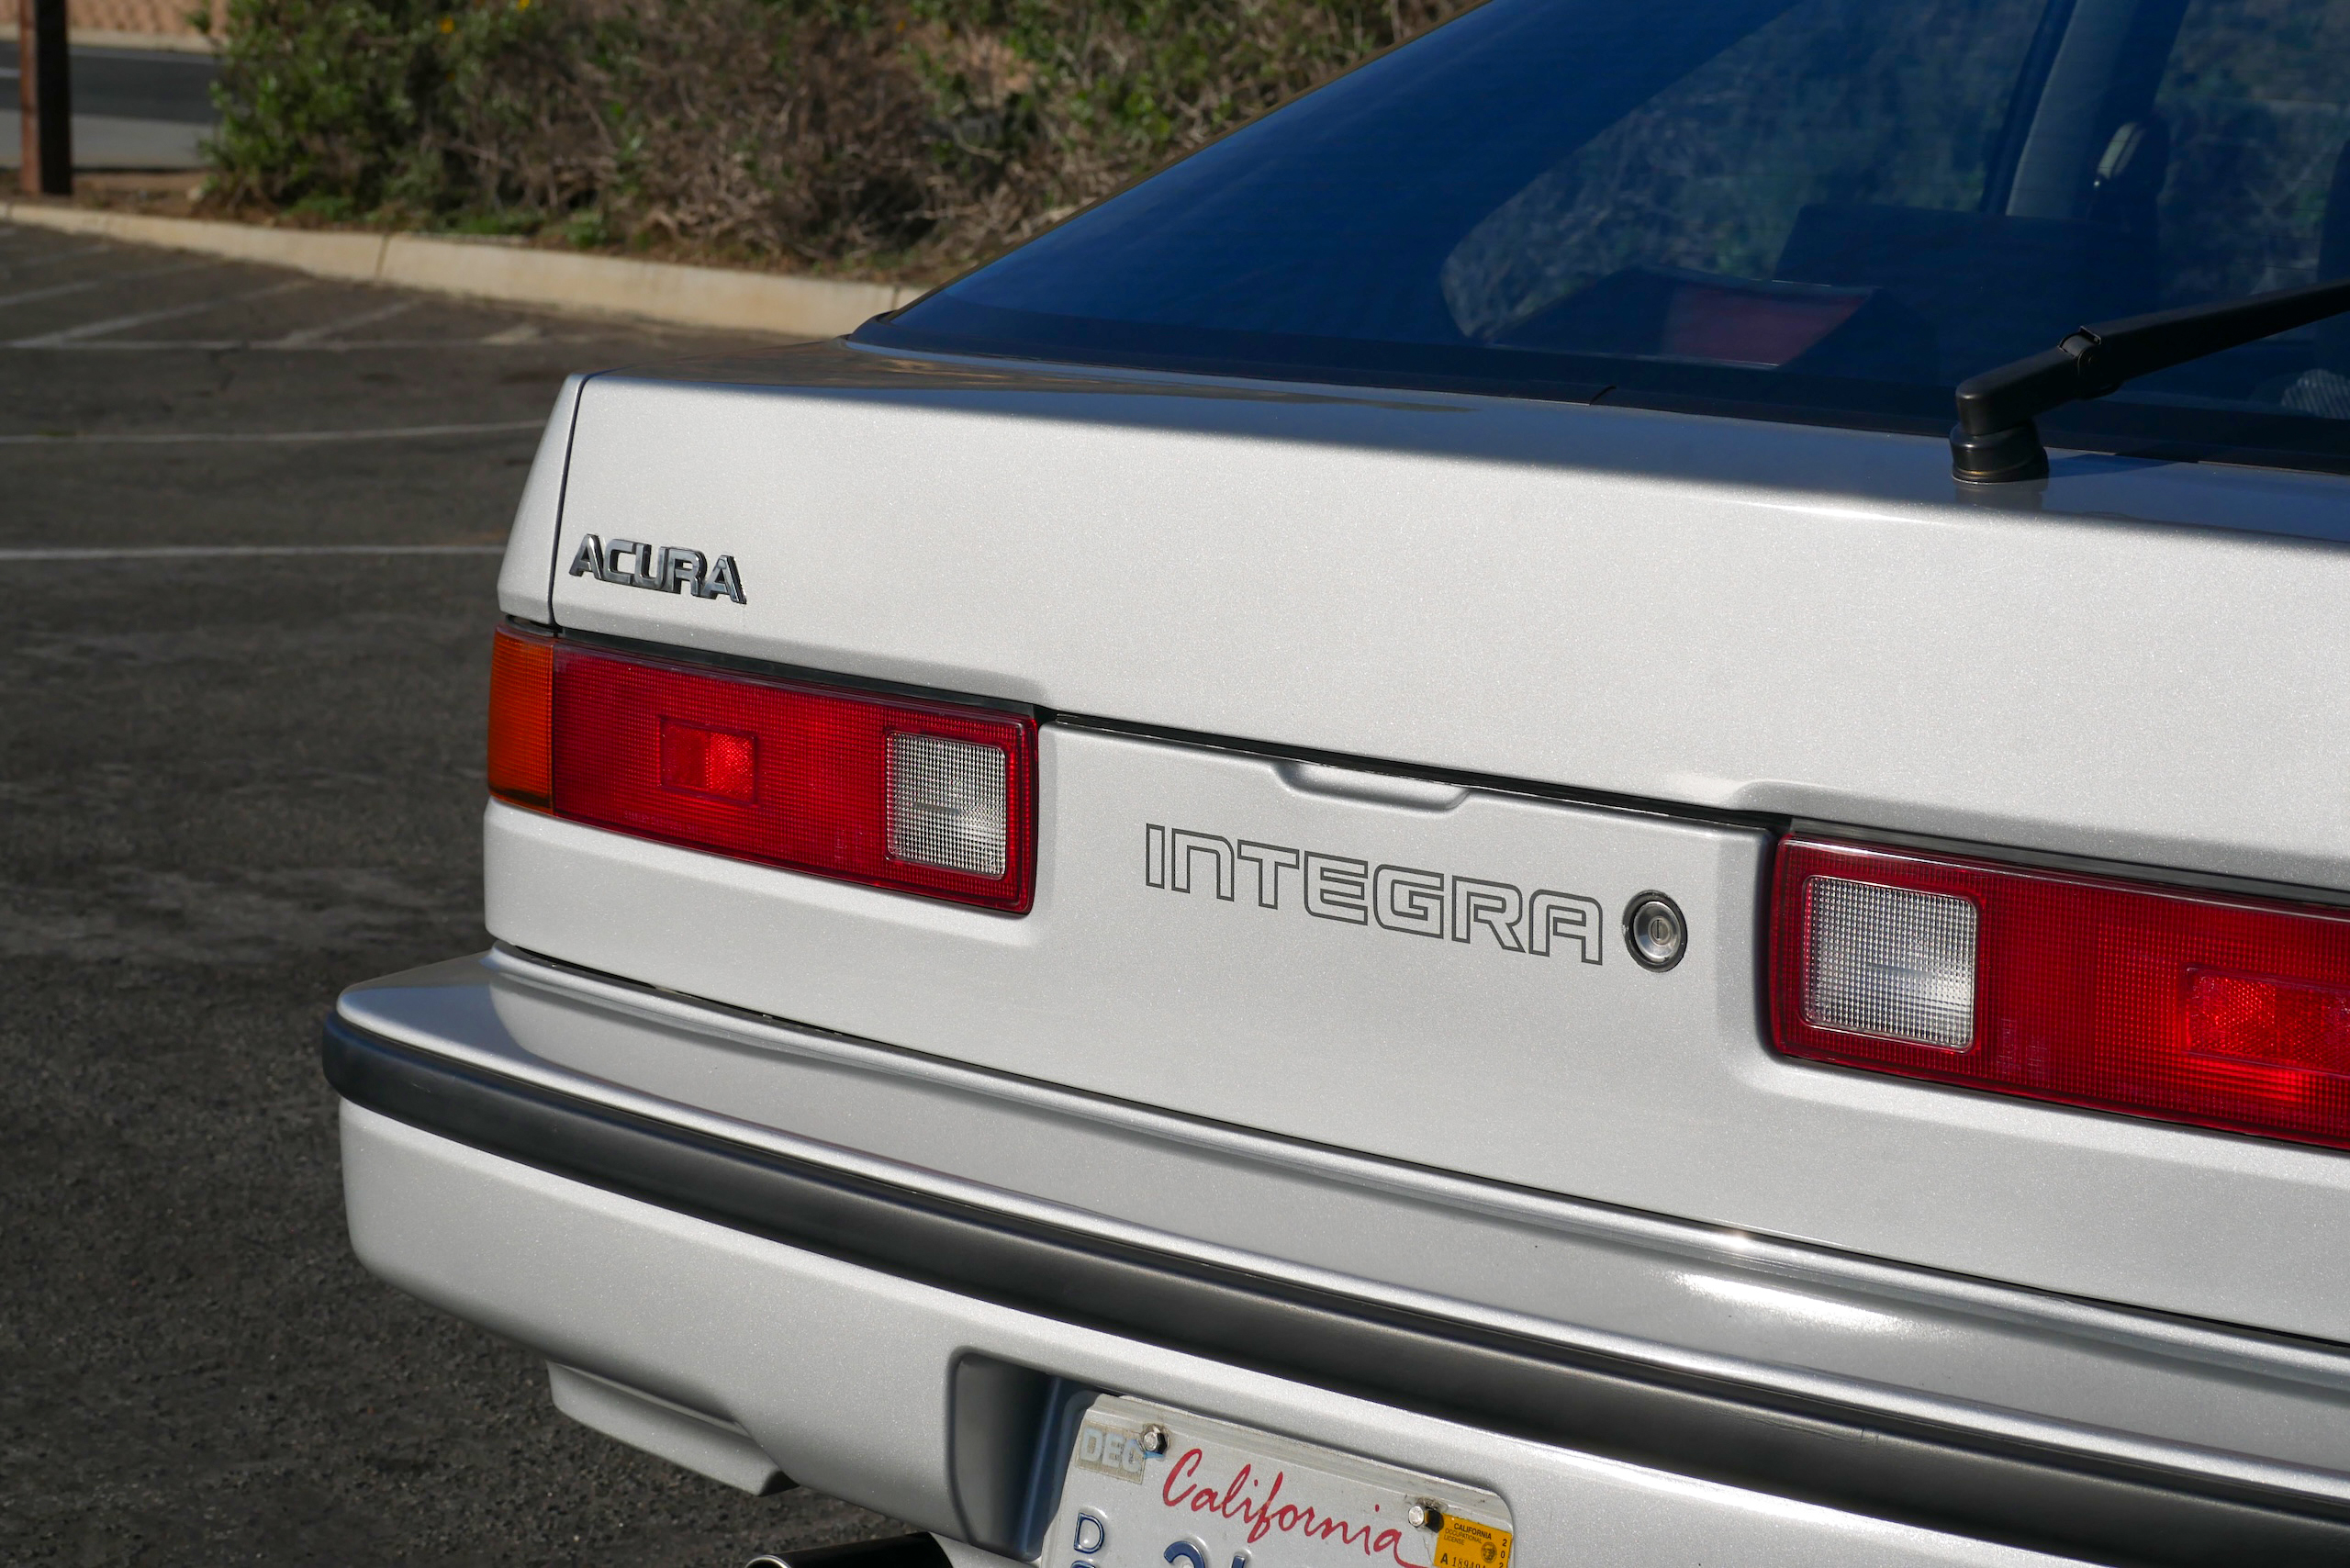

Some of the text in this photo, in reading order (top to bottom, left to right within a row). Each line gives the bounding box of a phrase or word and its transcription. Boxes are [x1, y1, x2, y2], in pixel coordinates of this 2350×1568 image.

[568, 532, 747, 605] ACURA
[1146, 823, 1603, 966] INTEGRA
[1079, 1427, 1145, 1473] DEC
[1162, 1448, 1428, 1568] California
[1453, 1522, 1492, 1540] CALIFORNIA
